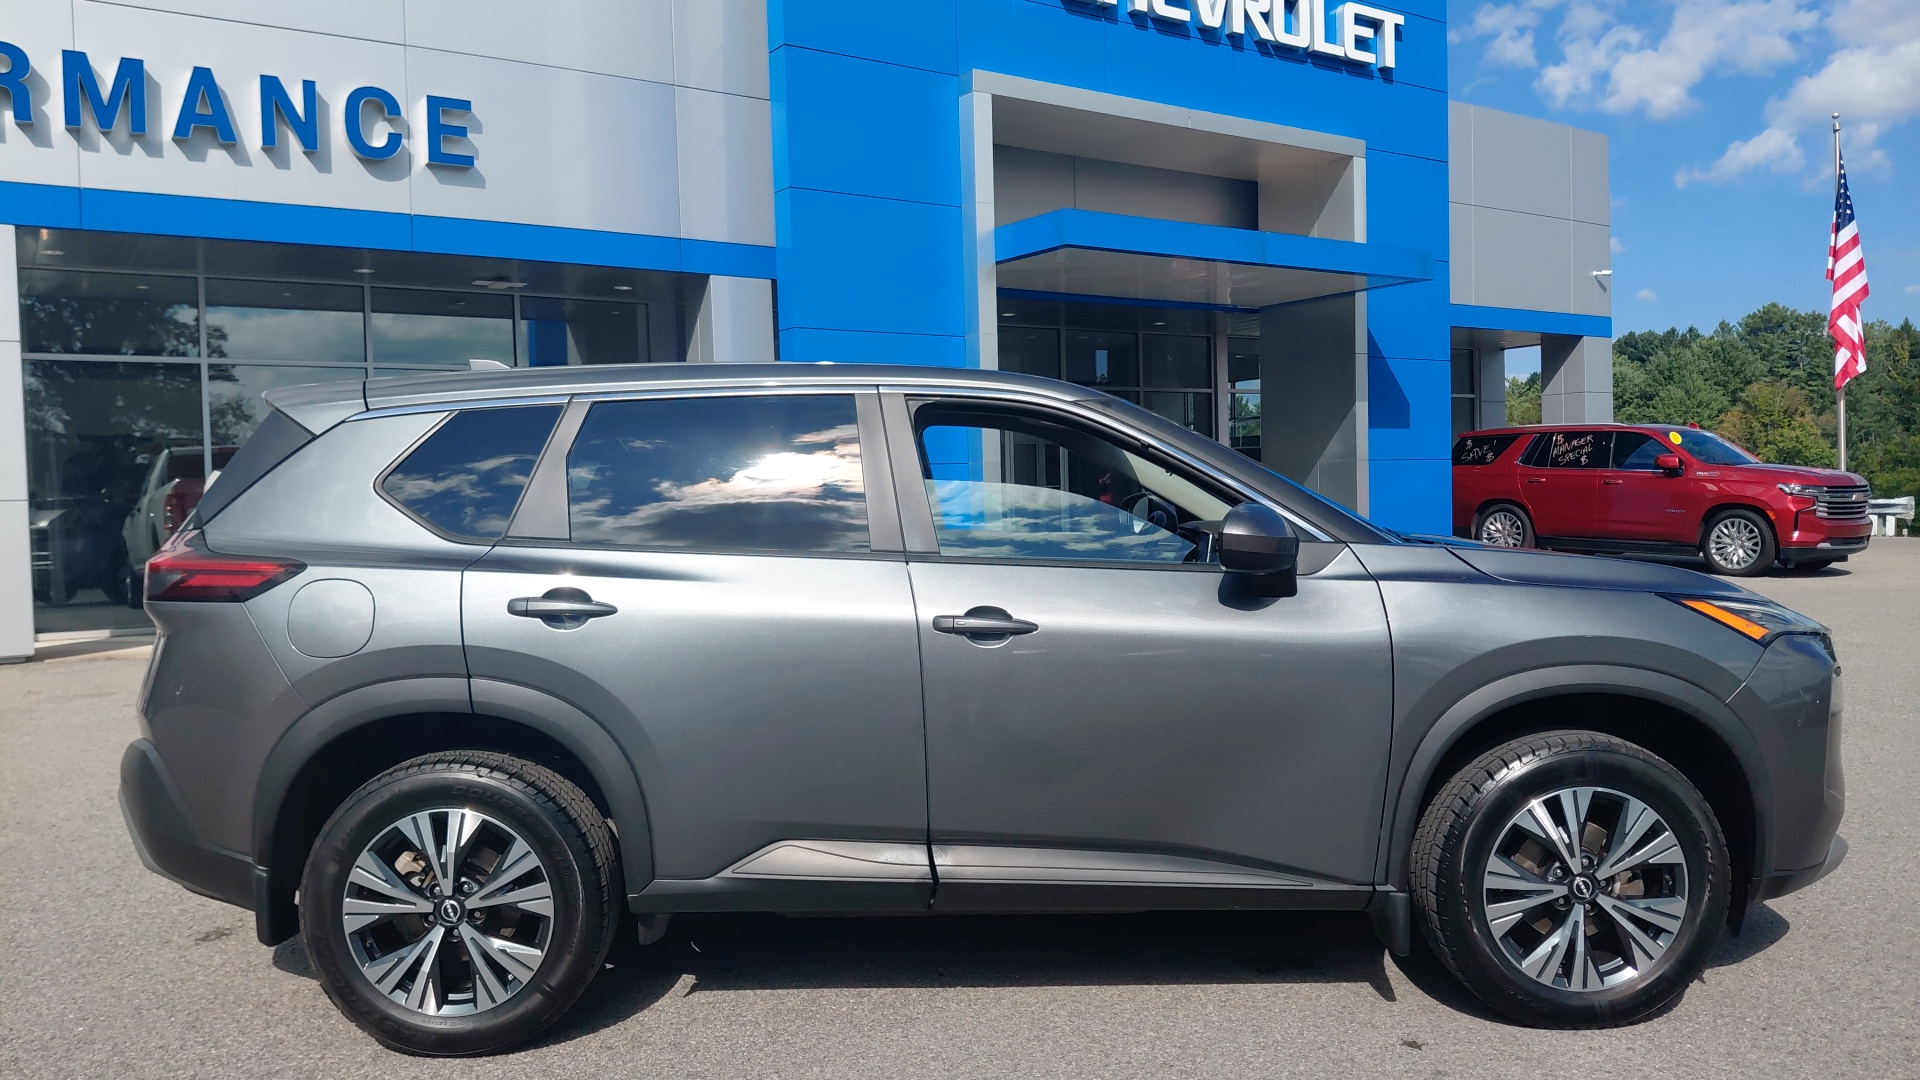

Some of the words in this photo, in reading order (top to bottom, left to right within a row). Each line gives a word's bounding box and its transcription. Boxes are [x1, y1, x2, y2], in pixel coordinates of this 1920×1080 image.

[1072, 0, 1406, 69] VROLET
[1553, 434, 1595, 458] MANAGER
[1558, 444, 1594, 466] SPECIAL
